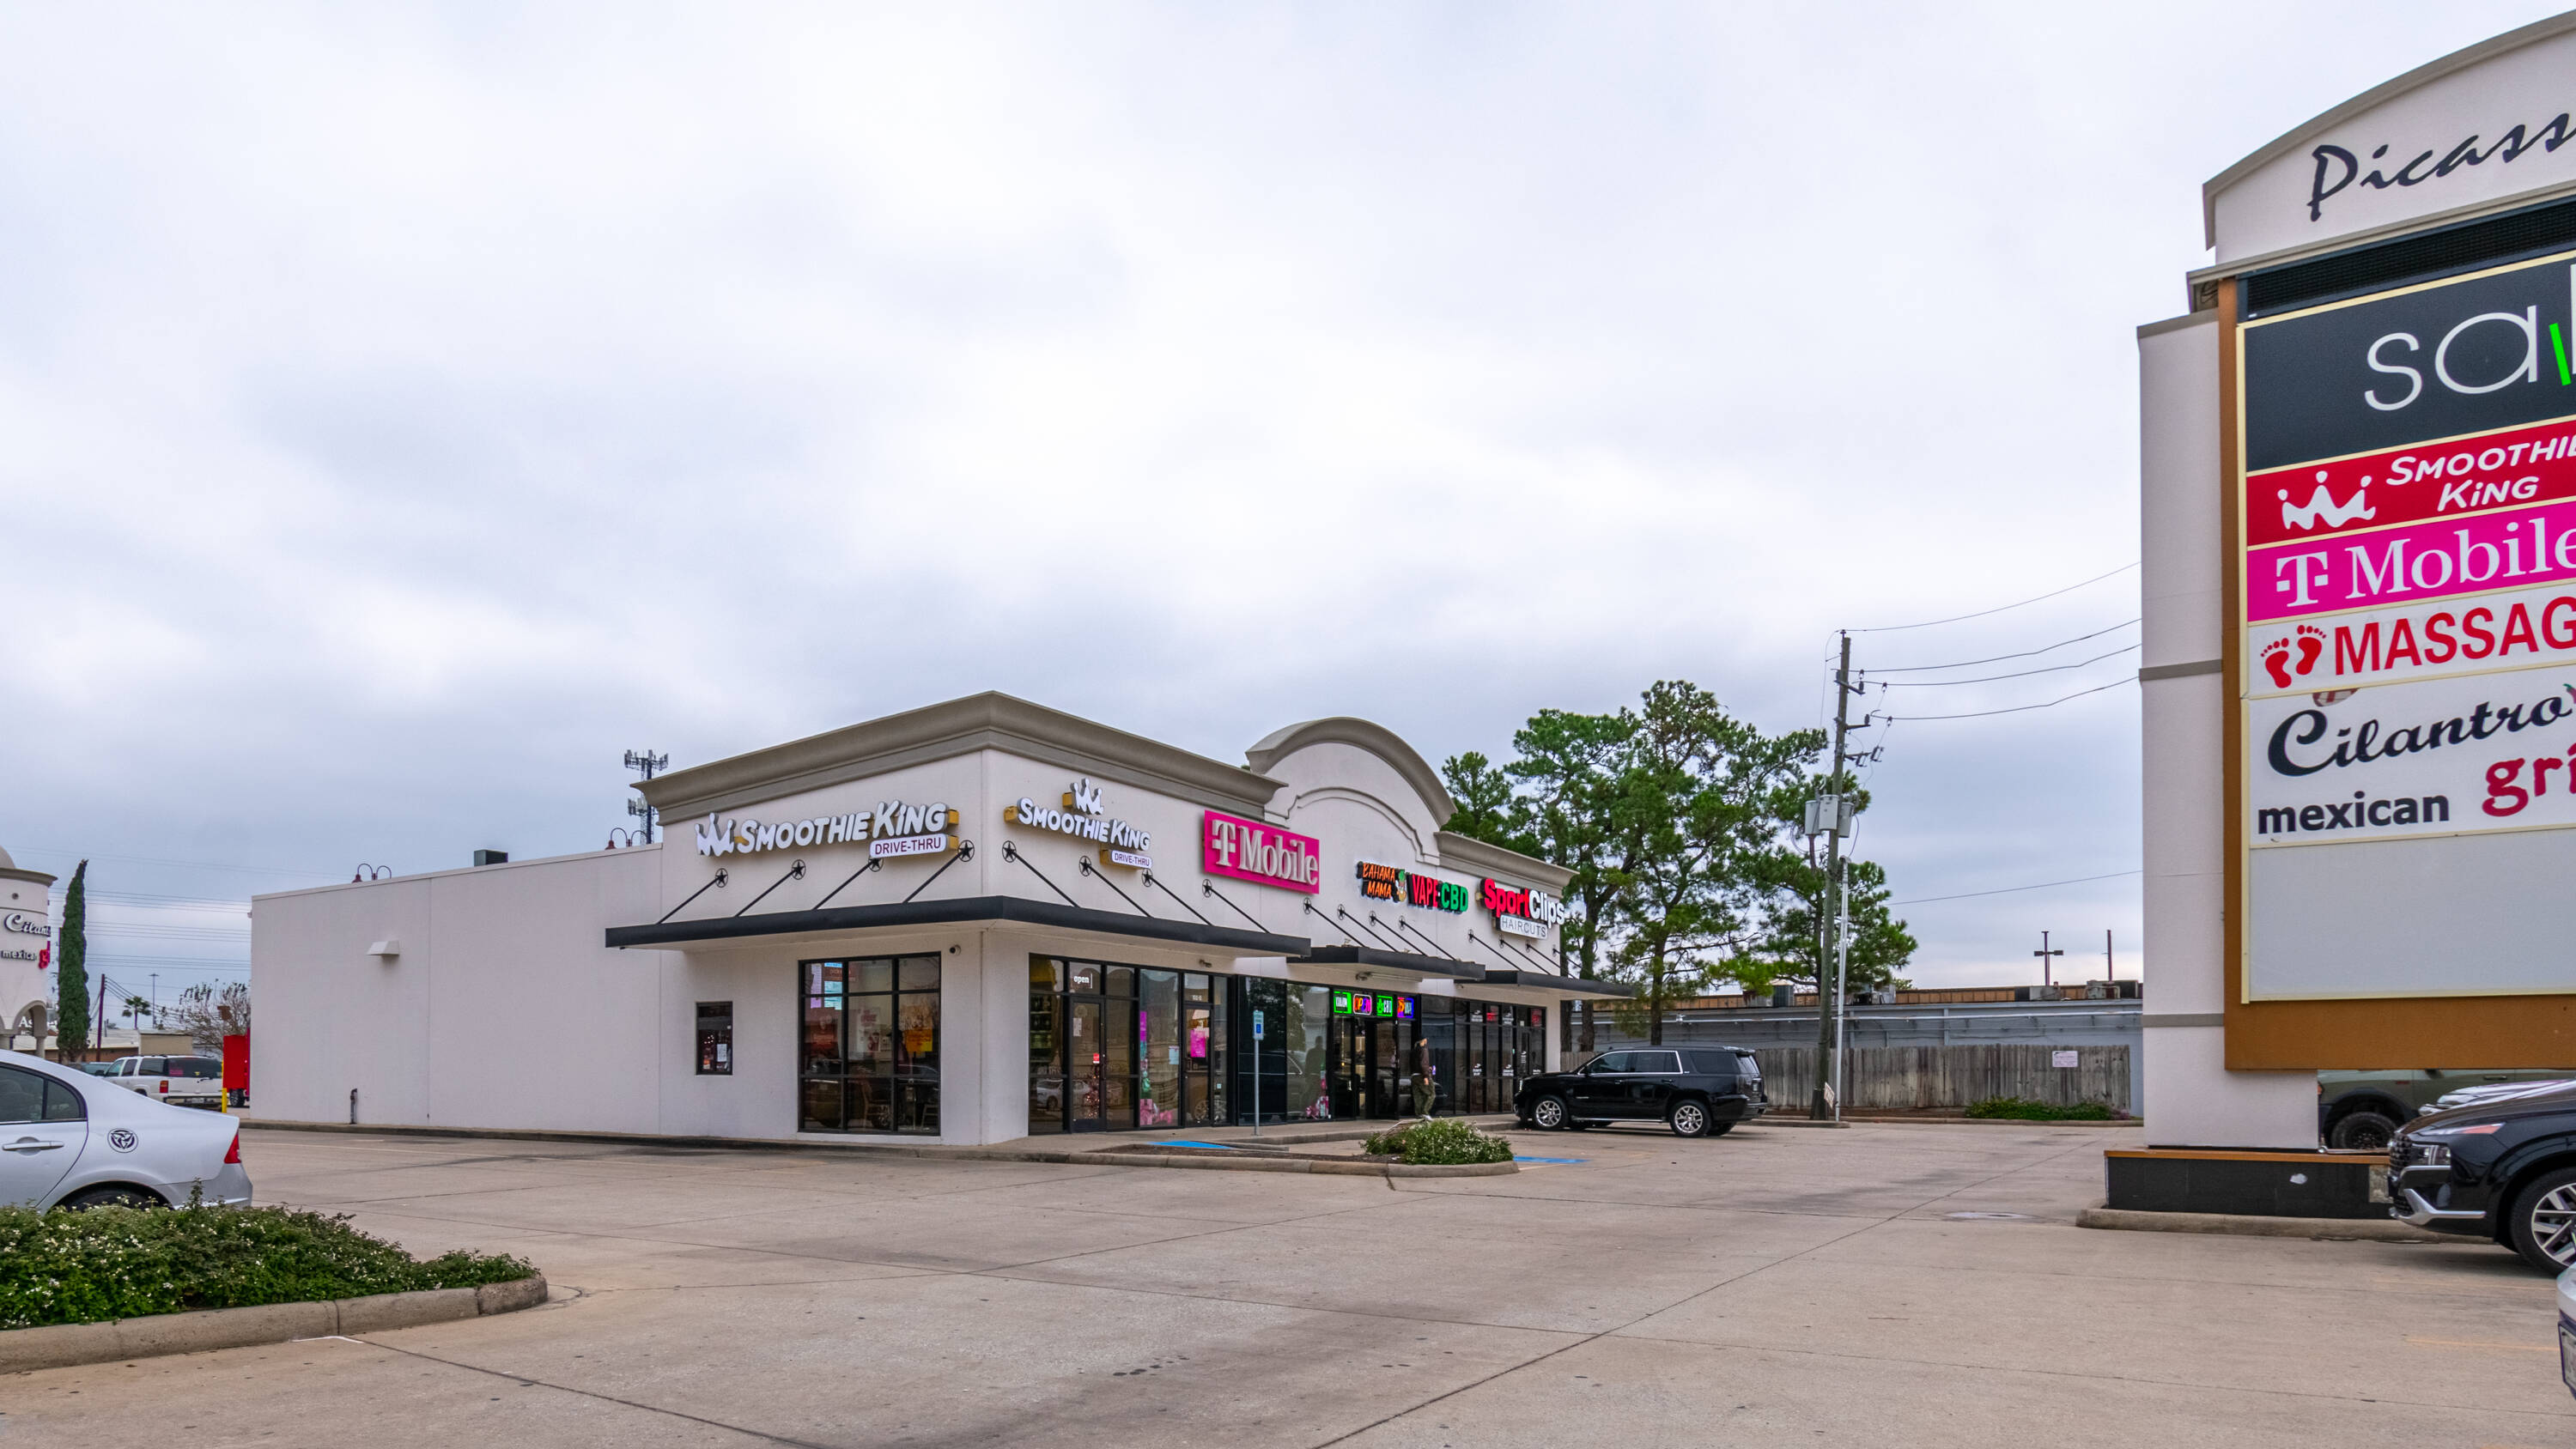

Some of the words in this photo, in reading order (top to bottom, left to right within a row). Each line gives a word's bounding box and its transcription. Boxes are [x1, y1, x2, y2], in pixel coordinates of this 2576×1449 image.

[1018, 797, 1110, 843] SMOOTHIE
[2257, 791, 2450, 834] mexican
[737, 810, 873, 854] SMOOTHIE
[874, 836, 942, 855] DRIVE-THRU
[1237, 825, 1318, 885] Mobile
[1114, 852, 1151, 867] DRIVE-THRU
[1363, 862, 1395, 883] BAHAMA
[1367, 881, 1392, 897] MAMA
[1412, 873, 1438, 907] VAPE
[1441, 882, 1468, 912] CBD
[1501, 915, 1546, 937] HAIRCUTS
[1073, 975, 1090, 985] open
[1353, 997, 1371, 1012] OPEN
